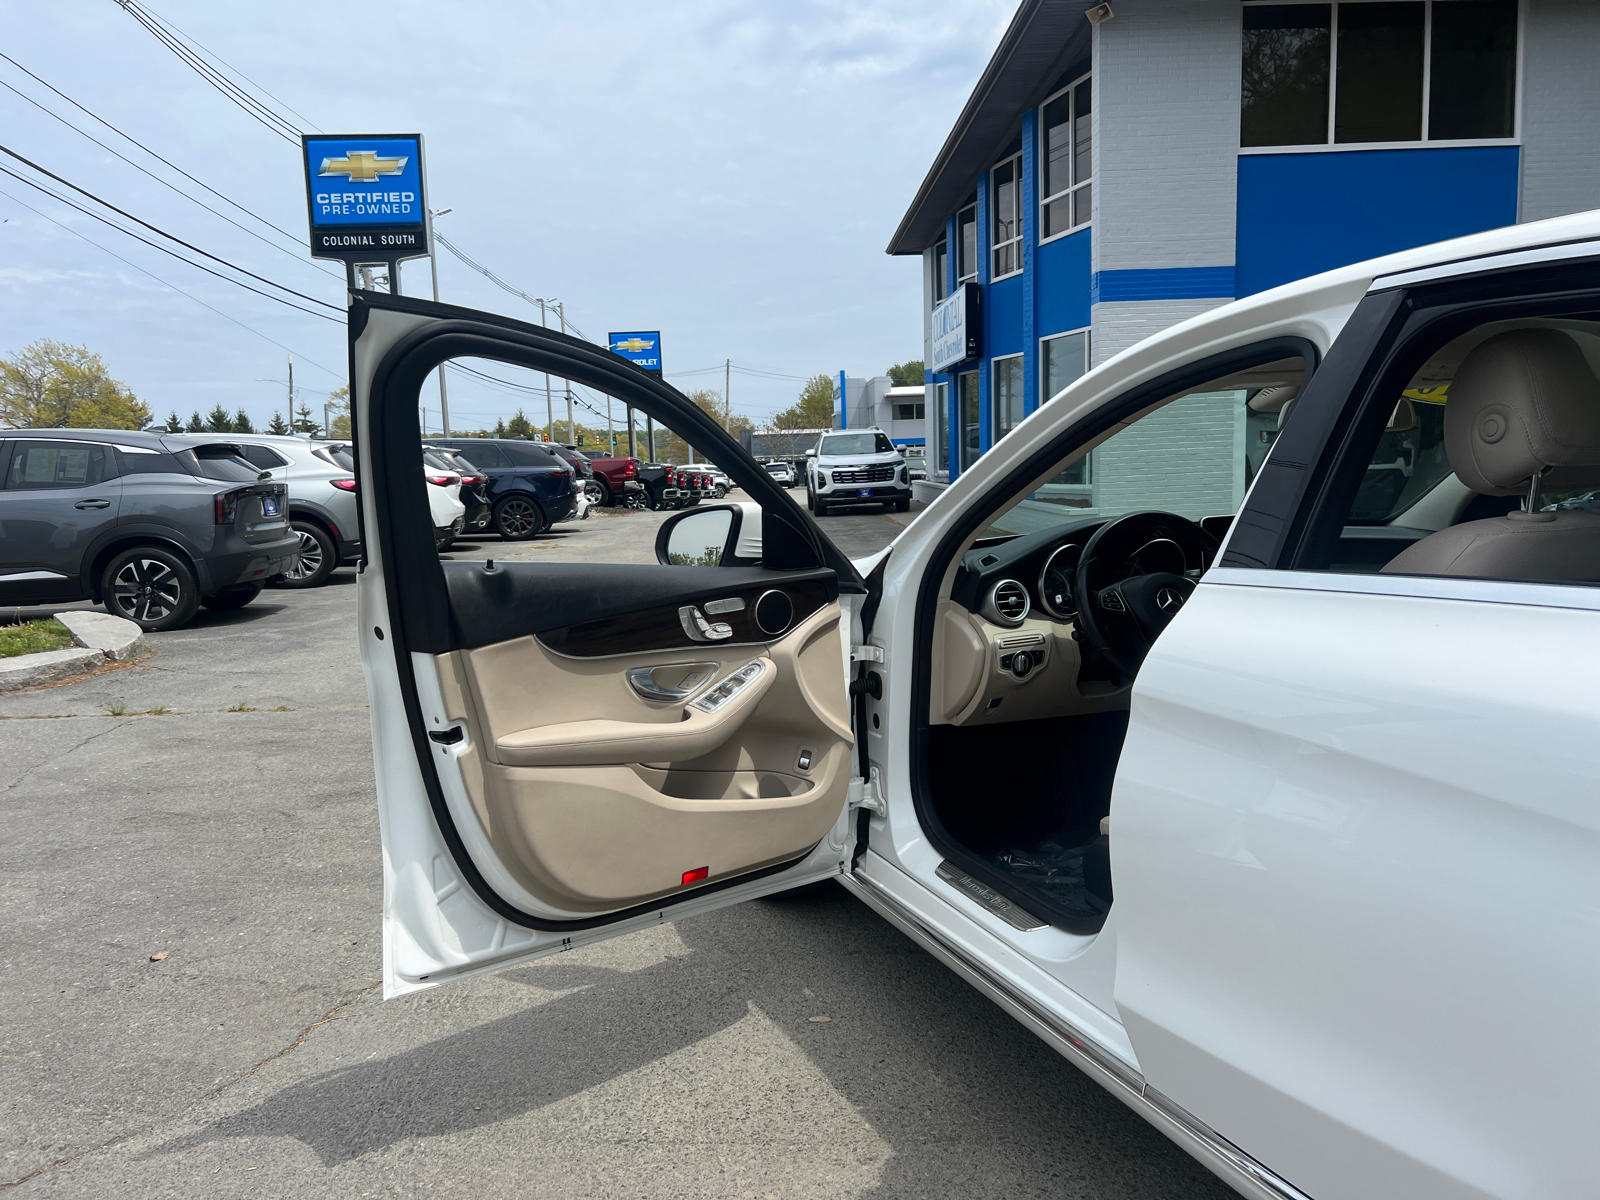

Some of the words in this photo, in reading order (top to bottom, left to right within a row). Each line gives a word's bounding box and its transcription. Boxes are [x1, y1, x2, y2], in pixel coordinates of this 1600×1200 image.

[316, 192, 415, 204] CERTIFIED
[322, 203, 411, 215] PRE-OWNED
[322, 235, 375, 246] COLONIAL
[381, 234, 415, 245] SOUTH
